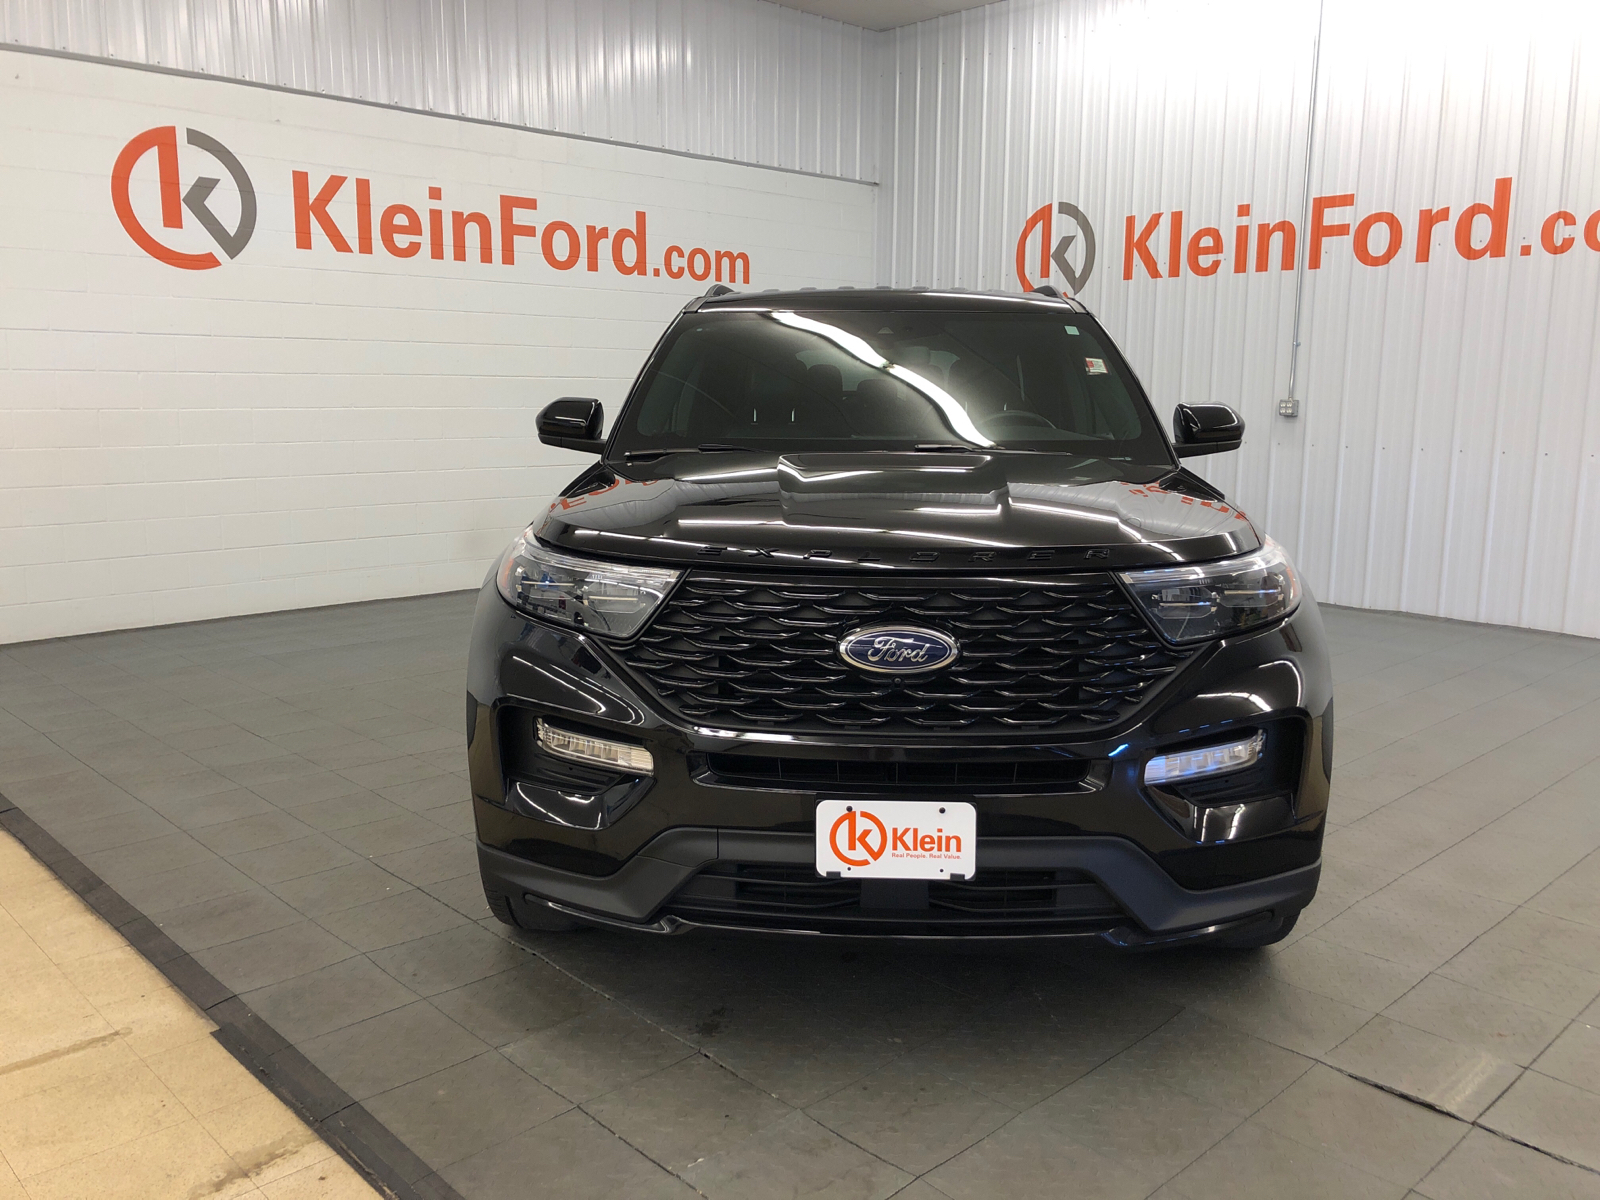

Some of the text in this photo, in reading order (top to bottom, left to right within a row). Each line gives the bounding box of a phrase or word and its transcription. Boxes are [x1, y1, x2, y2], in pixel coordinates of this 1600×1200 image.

[291, 169, 750, 285] KleinFord.com
[697, 545, 1111, 565] EXPLORER
[867, 636, 929, 663] Ford
[892, 827, 962, 852] Klein
[905, 852, 928, 860] People.
